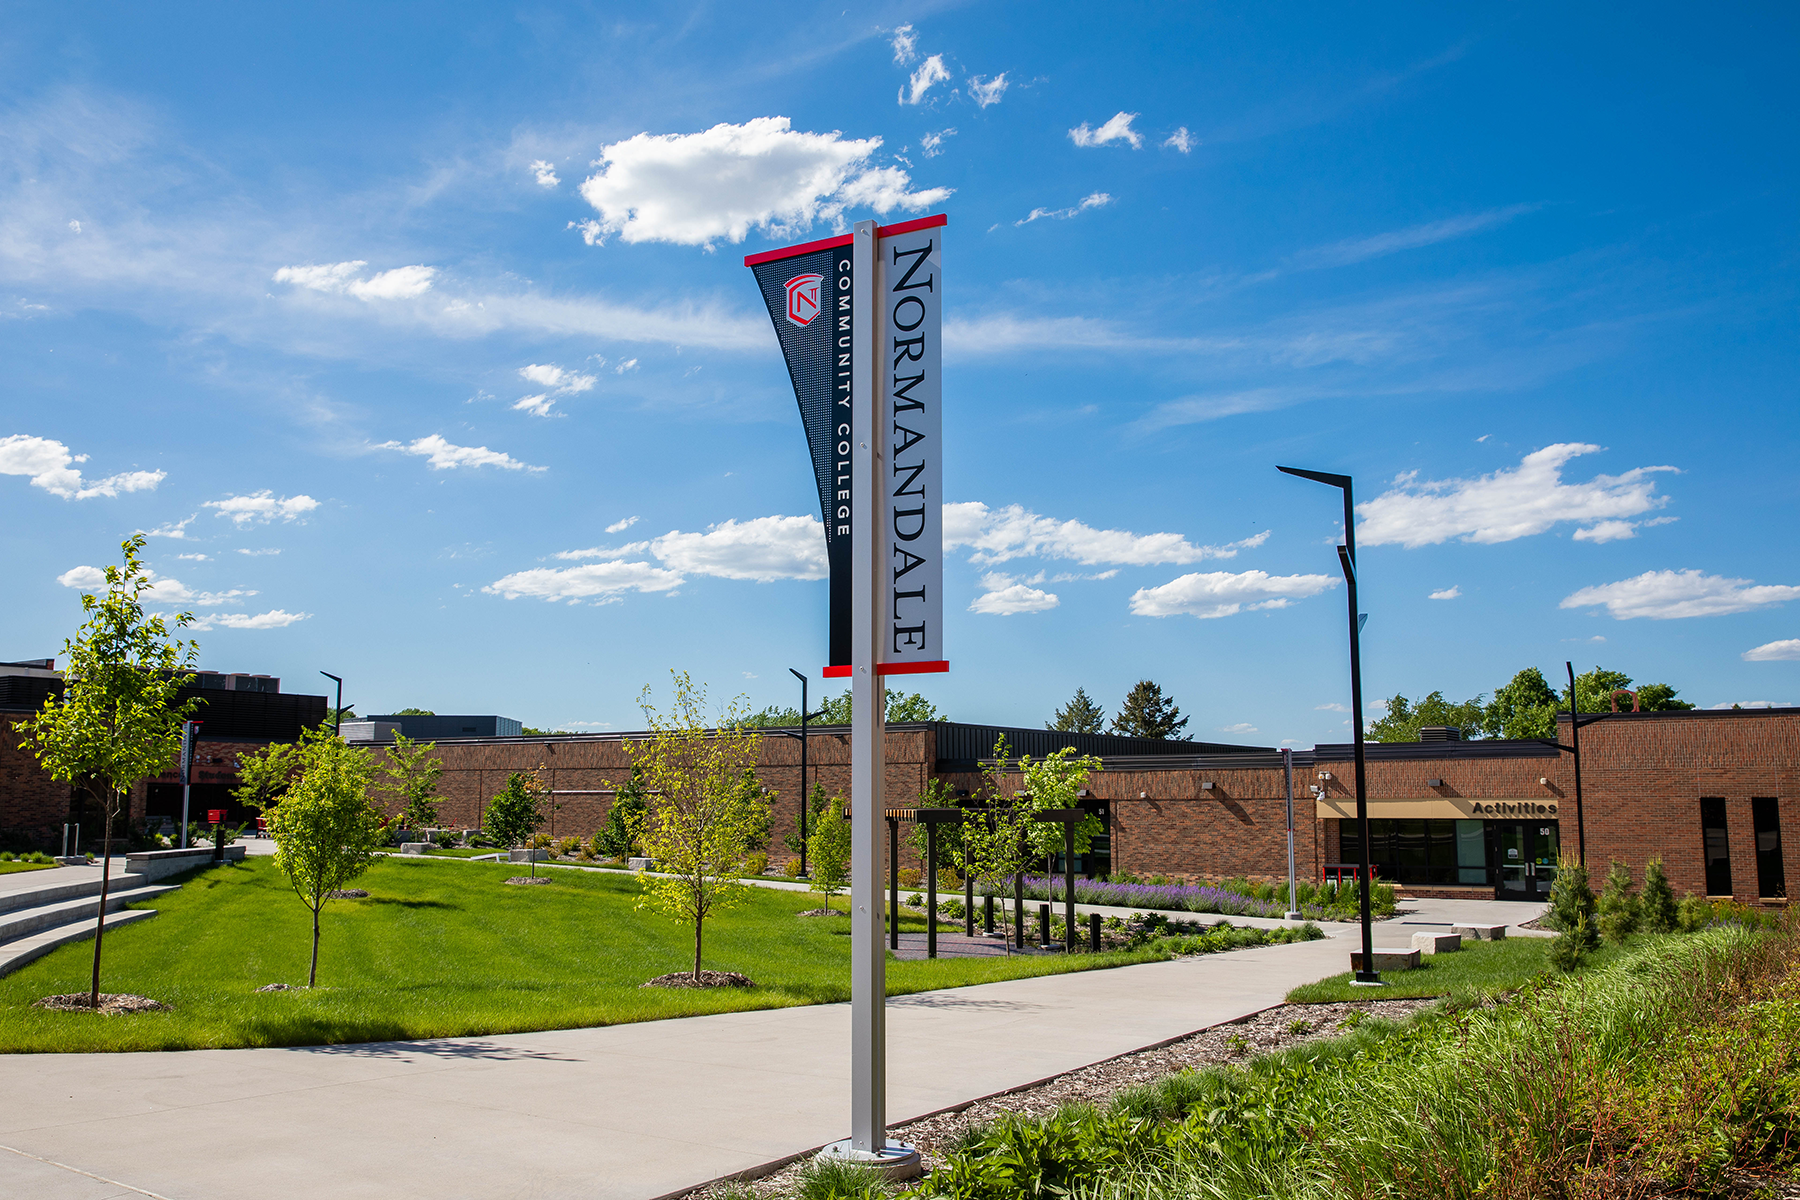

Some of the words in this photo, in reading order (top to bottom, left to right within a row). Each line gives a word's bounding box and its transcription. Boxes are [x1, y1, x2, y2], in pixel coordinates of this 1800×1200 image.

[838, 259, 850, 408] COMMUNITY
[838, 423, 850, 536] COLLEGE
[892, 238, 933, 653] NORMANDALE
[180, 724, 188, 783] NORMANDAE
[1472, 802, 1557, 814] Activities
[1540, 828, 1549, 836] 50
